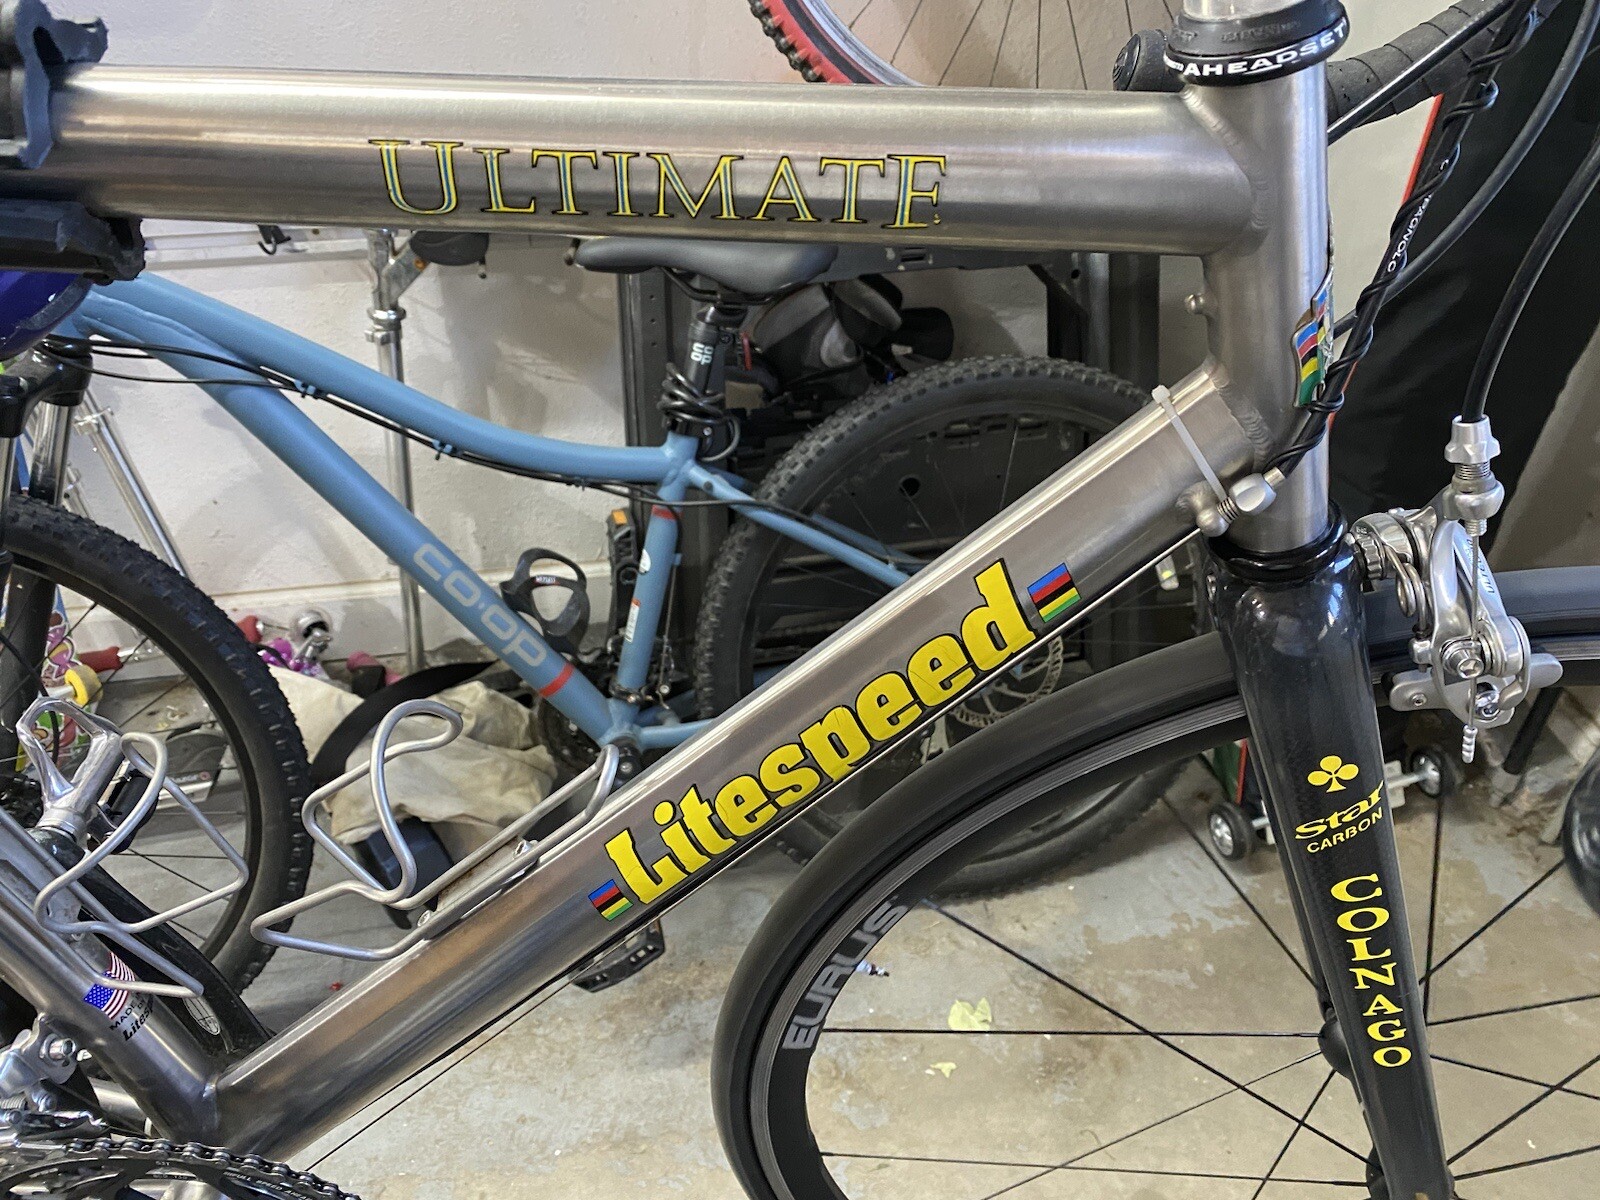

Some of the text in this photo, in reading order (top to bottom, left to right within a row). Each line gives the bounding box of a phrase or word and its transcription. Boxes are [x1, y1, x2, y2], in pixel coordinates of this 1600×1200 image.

[1183, 22, 1347, 76] AHEADSET
[368, 139, 947, 229] ULTIMATE
[604, 557, 1036, 905] Litespeed
[1294, 780, 1384, 840] Star
[1306, 807, 1384, 853] CARBON
[782, 900, 909, 1050] EURUS
[1330, 873, 1412, 1068] COLNAGO
[122, 996, 156, 1041] Litesp
